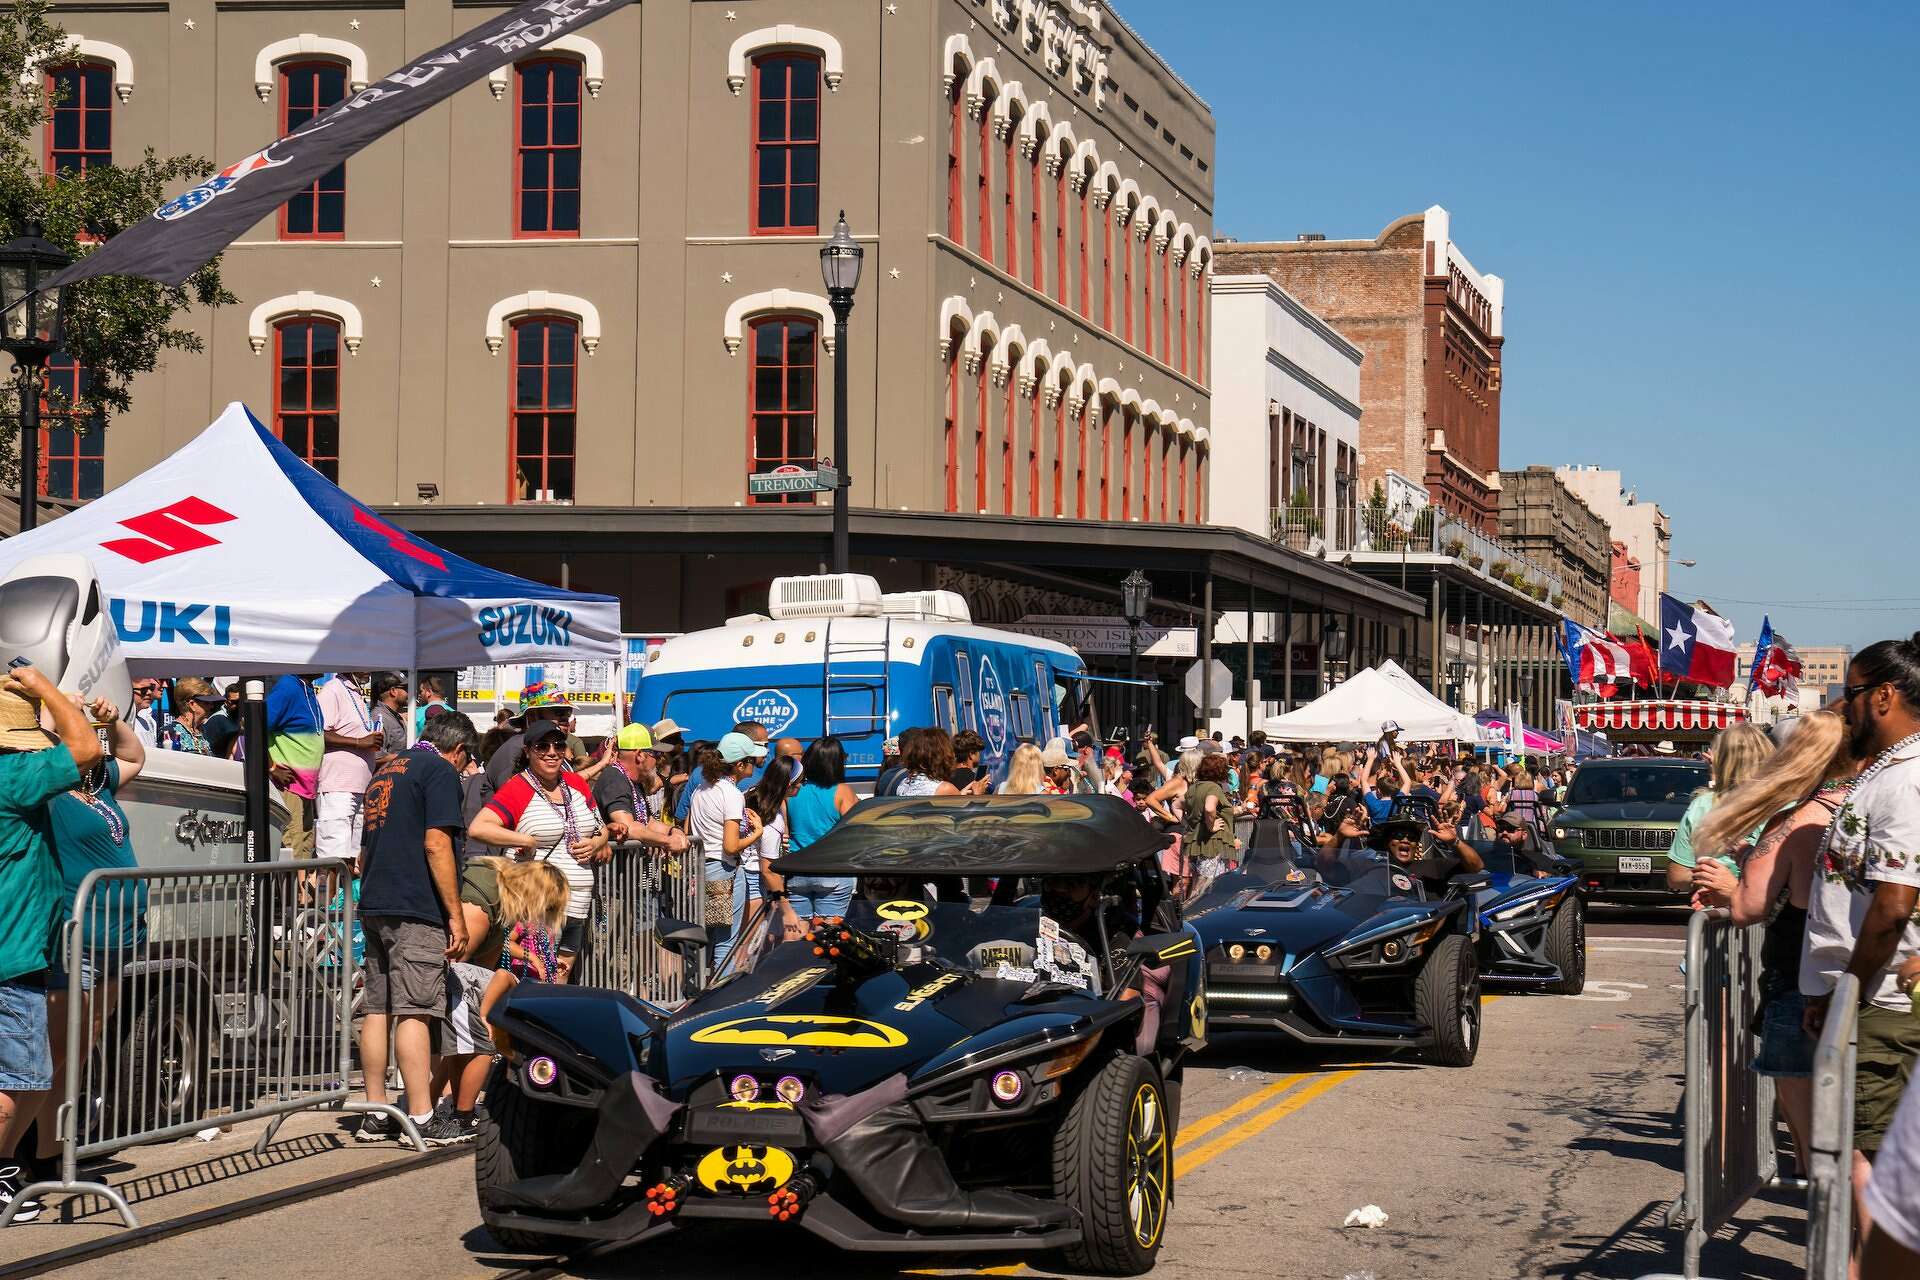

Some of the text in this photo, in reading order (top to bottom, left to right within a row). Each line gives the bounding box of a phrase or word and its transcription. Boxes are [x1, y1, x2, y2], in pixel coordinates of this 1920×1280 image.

[110, 598, 231, 646] UKI
[478, 604, 573, 647] SUZUKI
[457, 690, 479, 699] EER
[568, 692, 600, 702] BEER
[758, 698, 776, 706] IT'S
[740, 706, 791, 717] ISLAND
[753, 716, 776, 724] TIME
[247, 830, 255, 863] CENTERS
